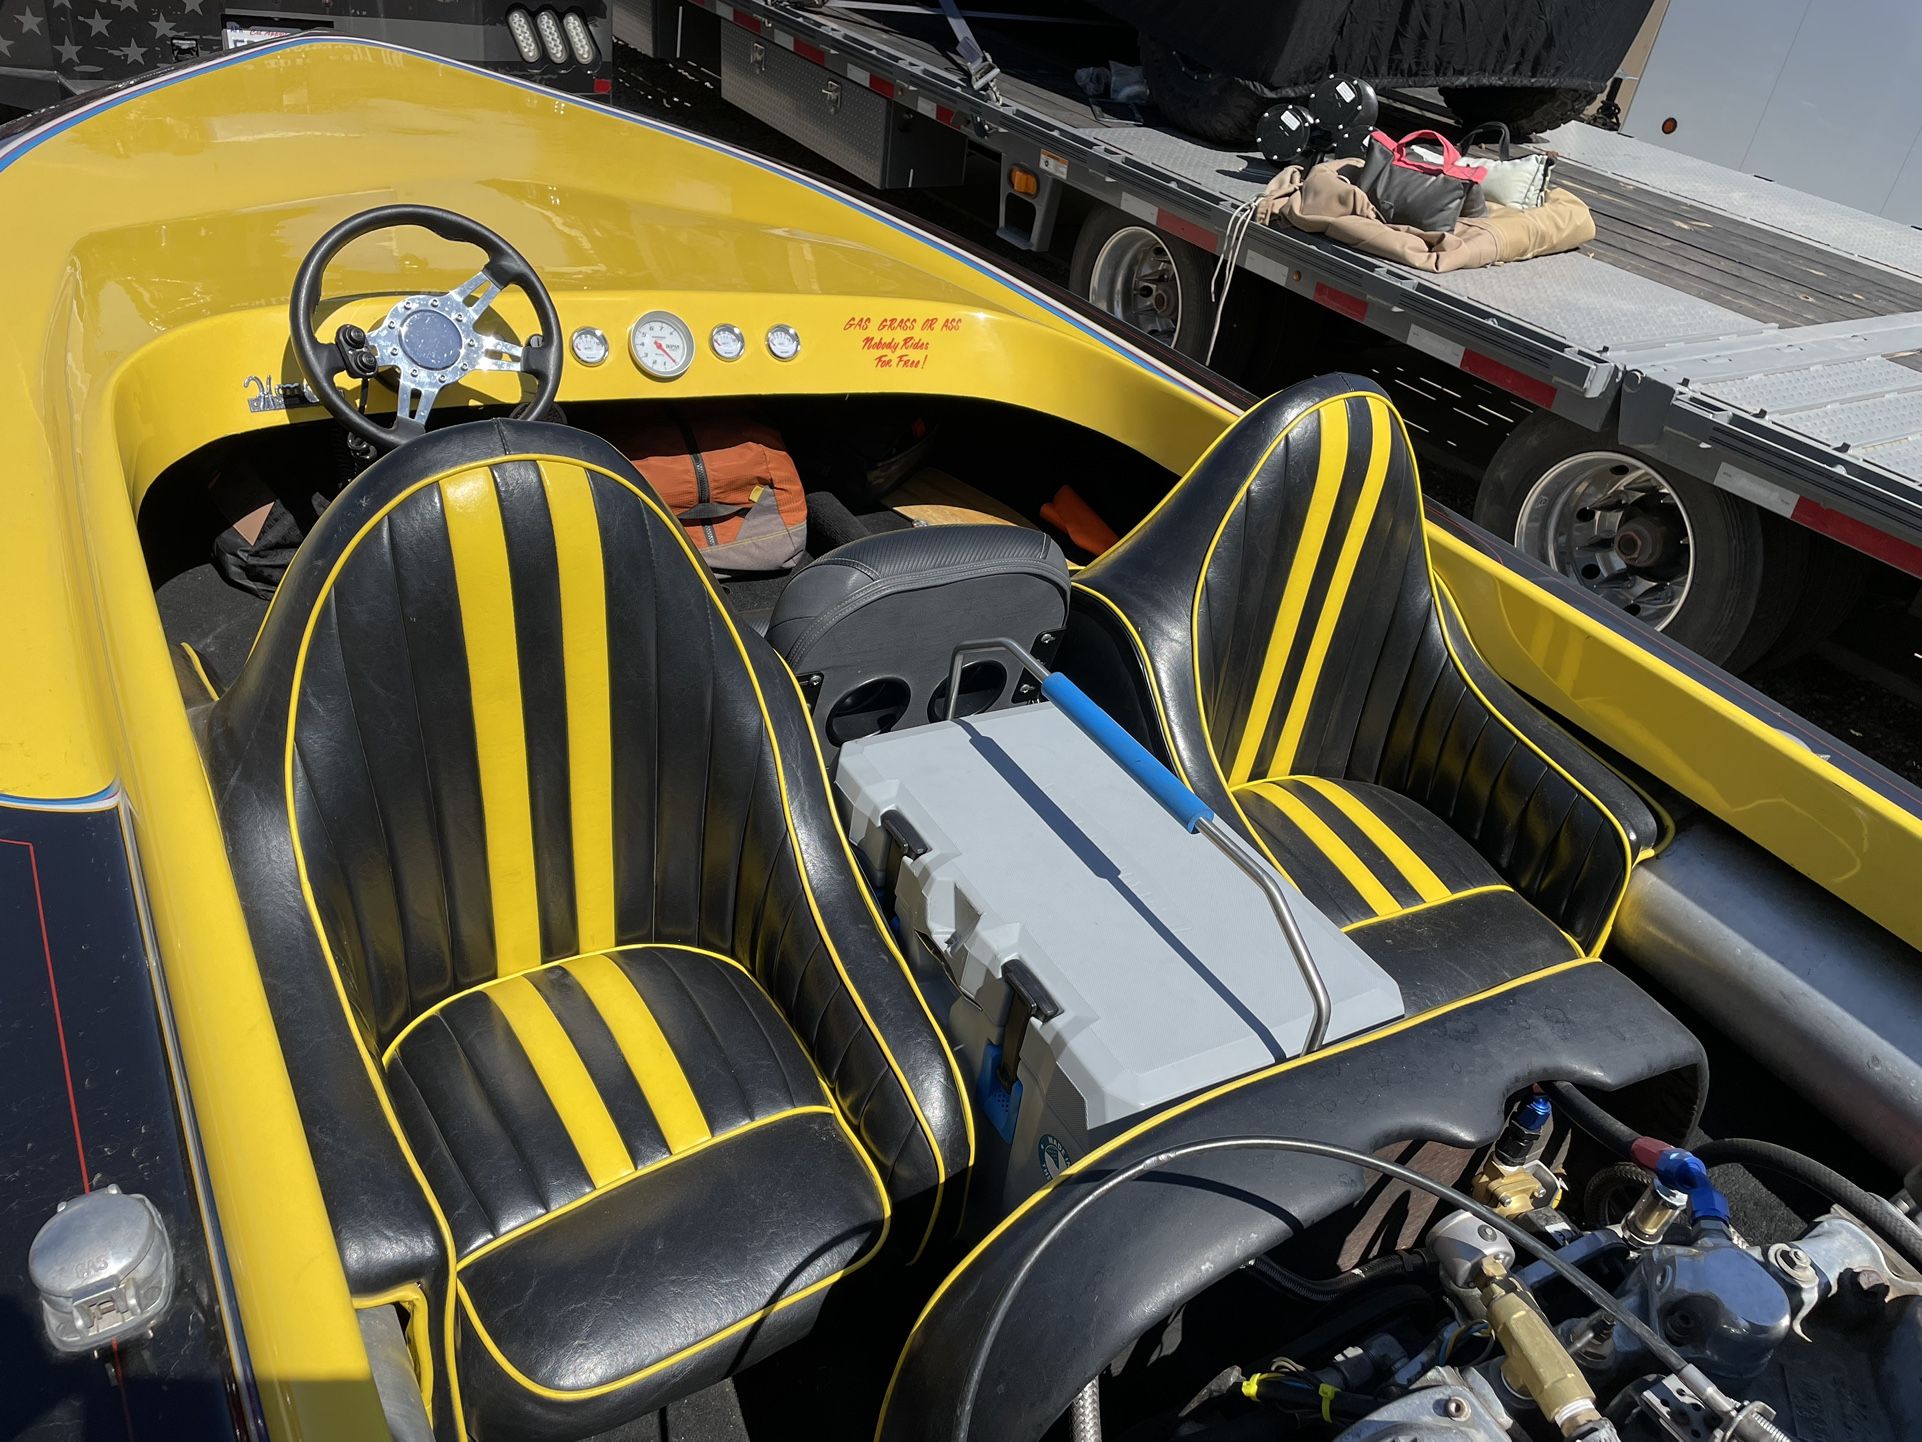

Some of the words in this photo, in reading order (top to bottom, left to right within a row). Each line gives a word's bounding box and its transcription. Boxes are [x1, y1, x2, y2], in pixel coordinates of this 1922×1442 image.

[843, 317, 872, 331] GAS
[877, 318, 917, 332] GRASS
[921, 317, 938, 331] OR
[941, 318, 962, 332] ASS
[861, 336, 899, 353] Nobody
[900, 336, 930, 351] Rides
[1047, 1136, 1066, 1156] MADE
[74, 1256, 109, 1279] GAS
